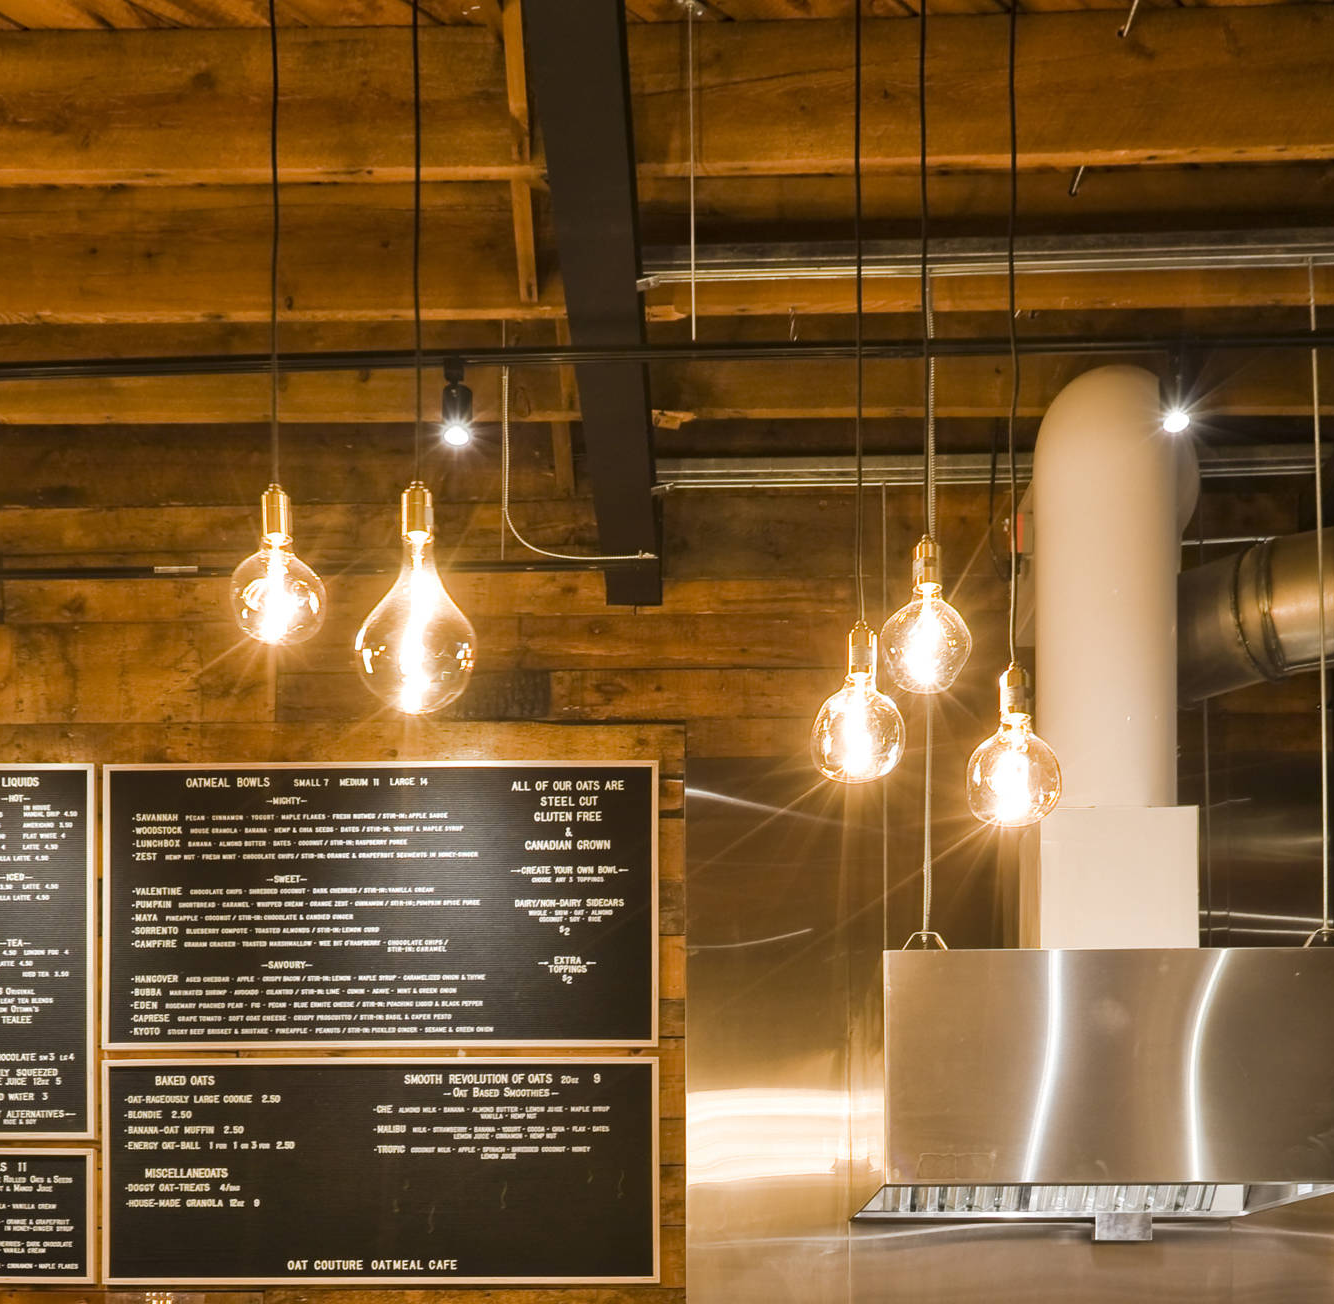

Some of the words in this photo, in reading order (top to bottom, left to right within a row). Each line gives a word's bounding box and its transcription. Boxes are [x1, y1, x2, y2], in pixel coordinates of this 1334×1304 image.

[2, 777, 39, 787] LIQUIDS
[186, 778, 230, 787] OATMEAL
[237, 777, 270, 787] BOWLS
[512, 781, 530, 791] ALL
[536, 781, 548, 791] OF
[553, 781, 571, 791] OUR
[576, 781, 600, 791] OATS
[605, 780, 625, 790] ARE
[540, 796, 575, 806] STEEL
[579, 796, 598, 806] CUT
[534, 812, 572, 822] GLUTEN
[577, 812, 602, 822] FREE
[565, 828, 572, 837] &
[525, 840, 571, 850] CANADIAN
[577, 840, 611, 850] GROWN
[560, 926, 570, 935] $2
[562, 975, 572, 984] $2
[155, 1076, 186, 1086] BAKED
[191, 1076, 215, 1086] OATS
[404, 1075, 442, 1084] SMOOTH
[449, 1074, 508, 1084] REVOLUTION
[512, 1074, 523, 1084] OF
[528, 1074, 553, 1084] OATS
[594, 1074, 601, 1083] 9
[18, 1162, 27, 1172] 11
[145, 1168, 228, 1178] MISCELLANEOATS
[288, 1260, 306, 1270] OAT
[314, 1260, 363, 1270] COUTURE
[371, 1260, 423, 1270] OATMEAL
[429, 1260, 457, 1270] CAFE
